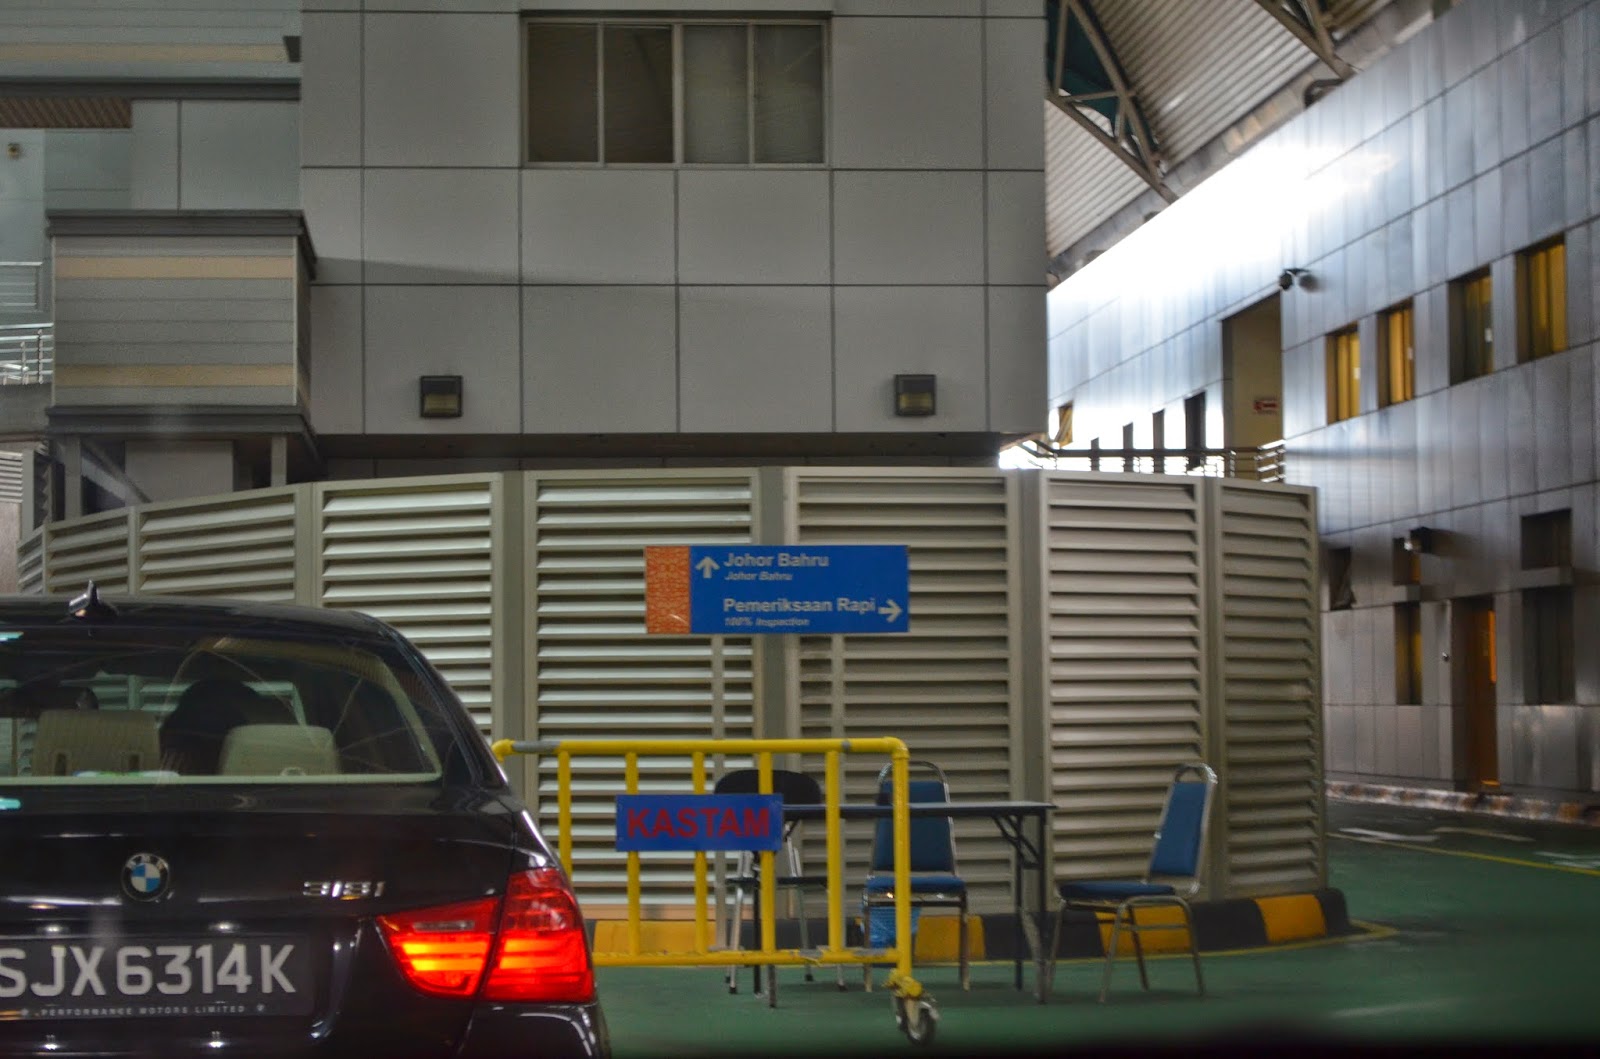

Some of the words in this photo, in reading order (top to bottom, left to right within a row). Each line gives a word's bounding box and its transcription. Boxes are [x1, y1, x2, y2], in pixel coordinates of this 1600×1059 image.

[724, 553, 774, 567] Johor
[778, 553, 829, 567] Bahru
[724, 571, 757, 581] Johor
[759, 571, 793, 581] Bahru
[723, 598, 833, 612] Pemeriksaan
[836, 598, 876, 615] Rapi
[627, 807, 770, 838] KASTAM
[195, 1005, 245, 1014] LIMITED
